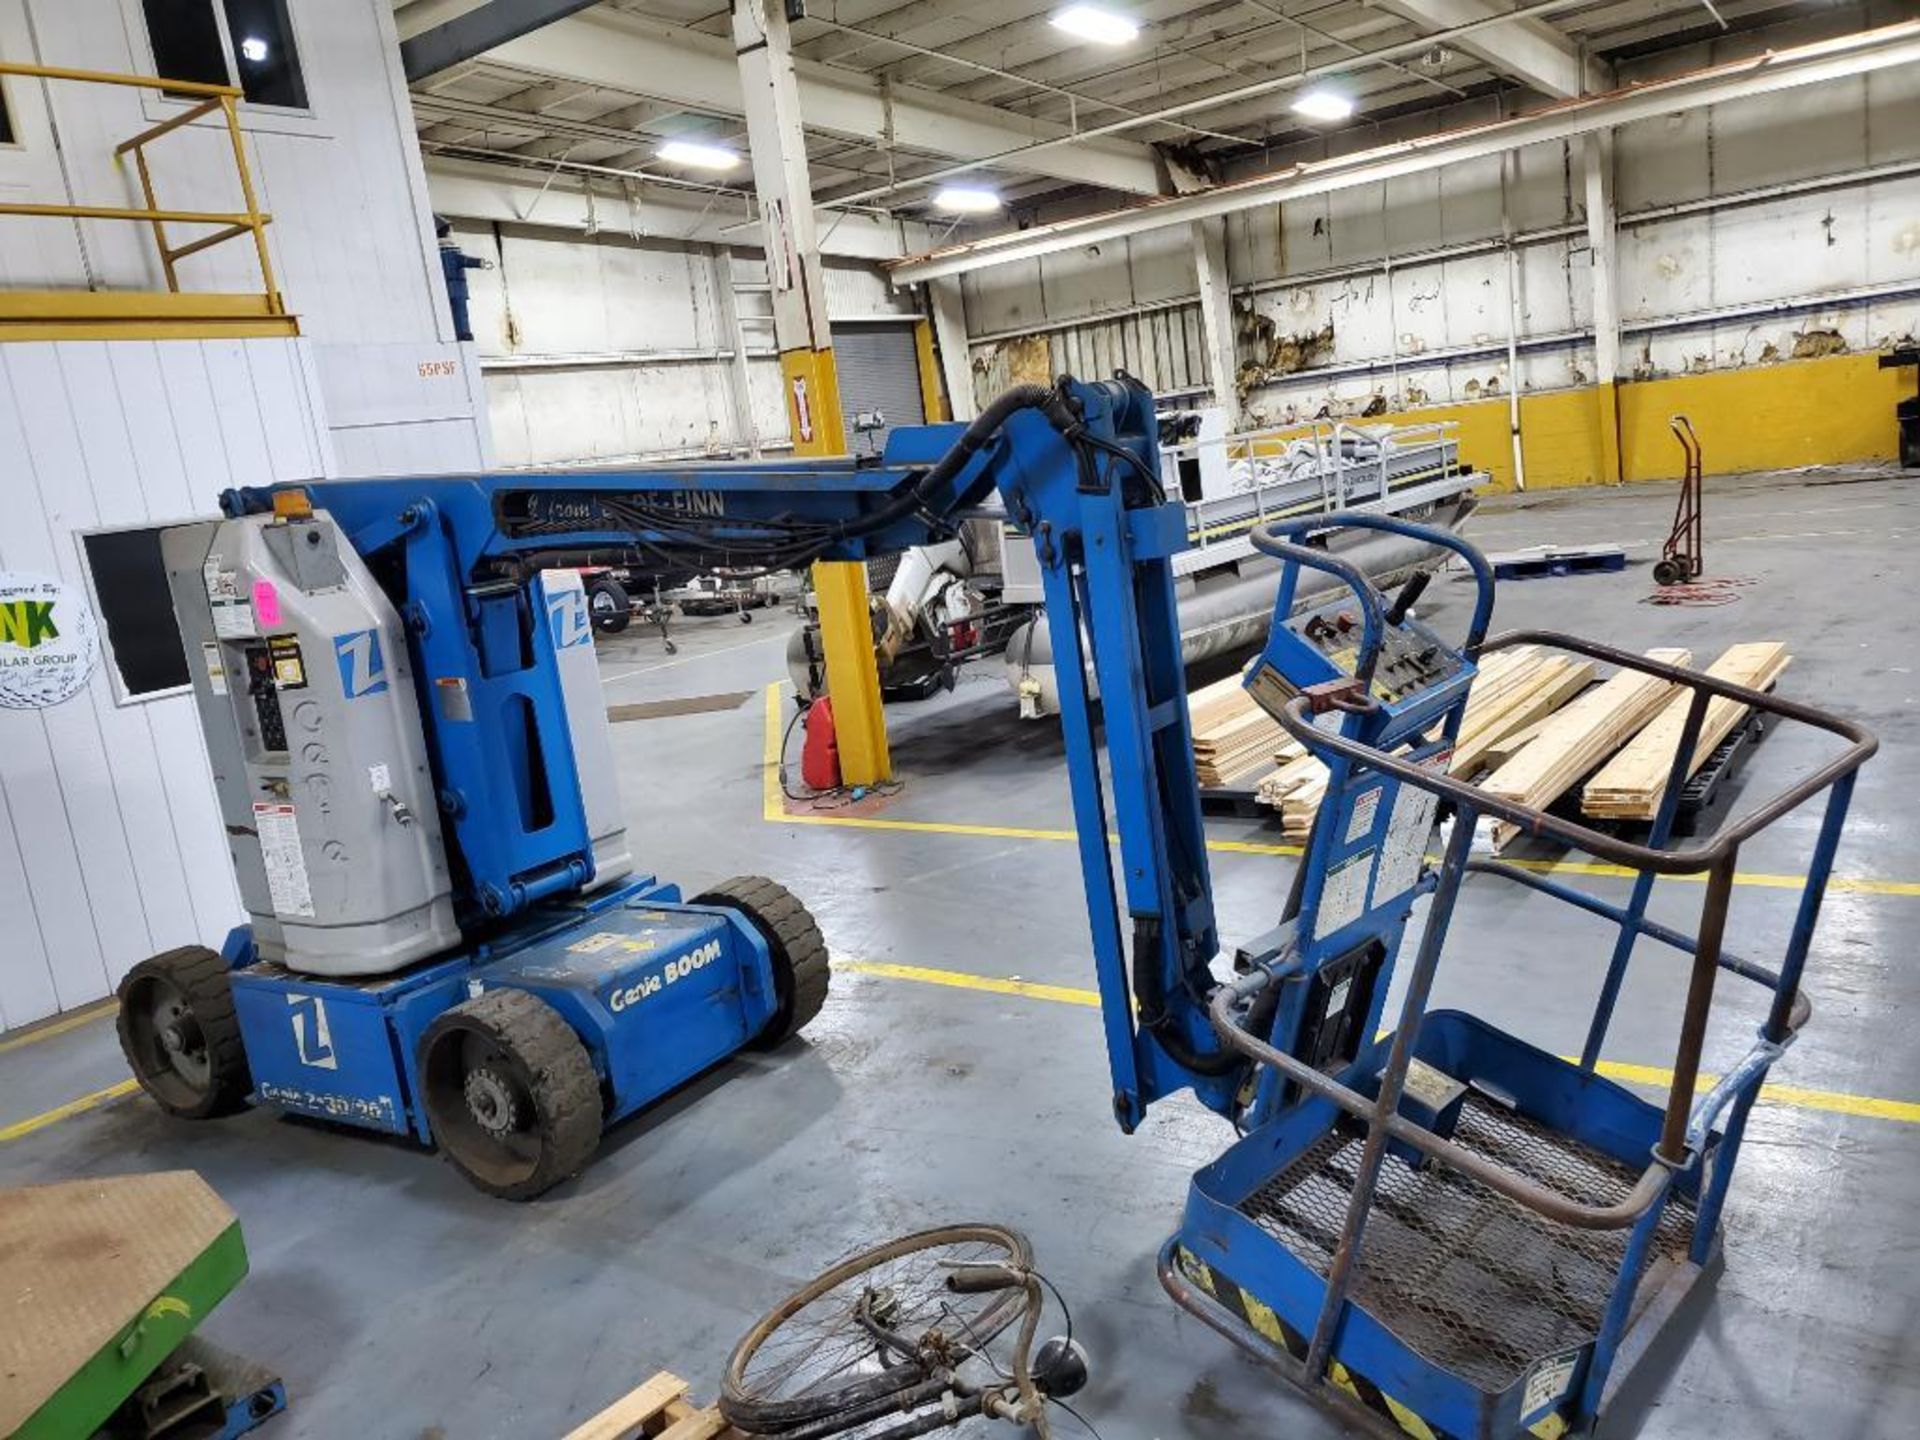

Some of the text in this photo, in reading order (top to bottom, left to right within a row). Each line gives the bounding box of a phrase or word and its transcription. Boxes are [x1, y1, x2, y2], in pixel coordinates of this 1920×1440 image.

[33, 653, 77, 666] GROUP
[610, 975, 662, 1012] Genie
[664, 939, 721, 985] BOOM
